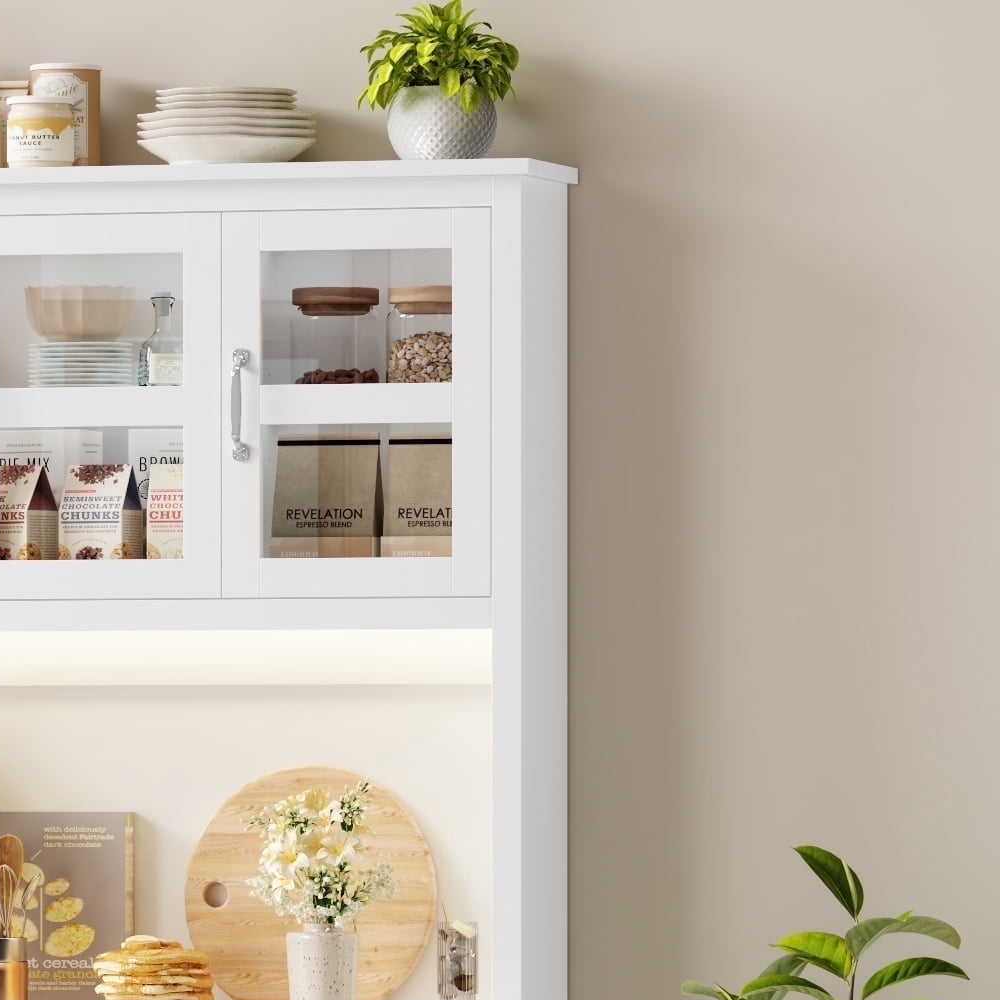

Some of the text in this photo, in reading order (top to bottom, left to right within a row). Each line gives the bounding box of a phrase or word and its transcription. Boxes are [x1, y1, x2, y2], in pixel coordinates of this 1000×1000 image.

[63, 495, 122, 503] SEMISWEET
[60, 511, 120, 521] CHUNKS
[286, 508, 363, 520] REVELATION
[397, 507, 452, 520] REVELAT
[63, 826, 106, 834] deliciously
